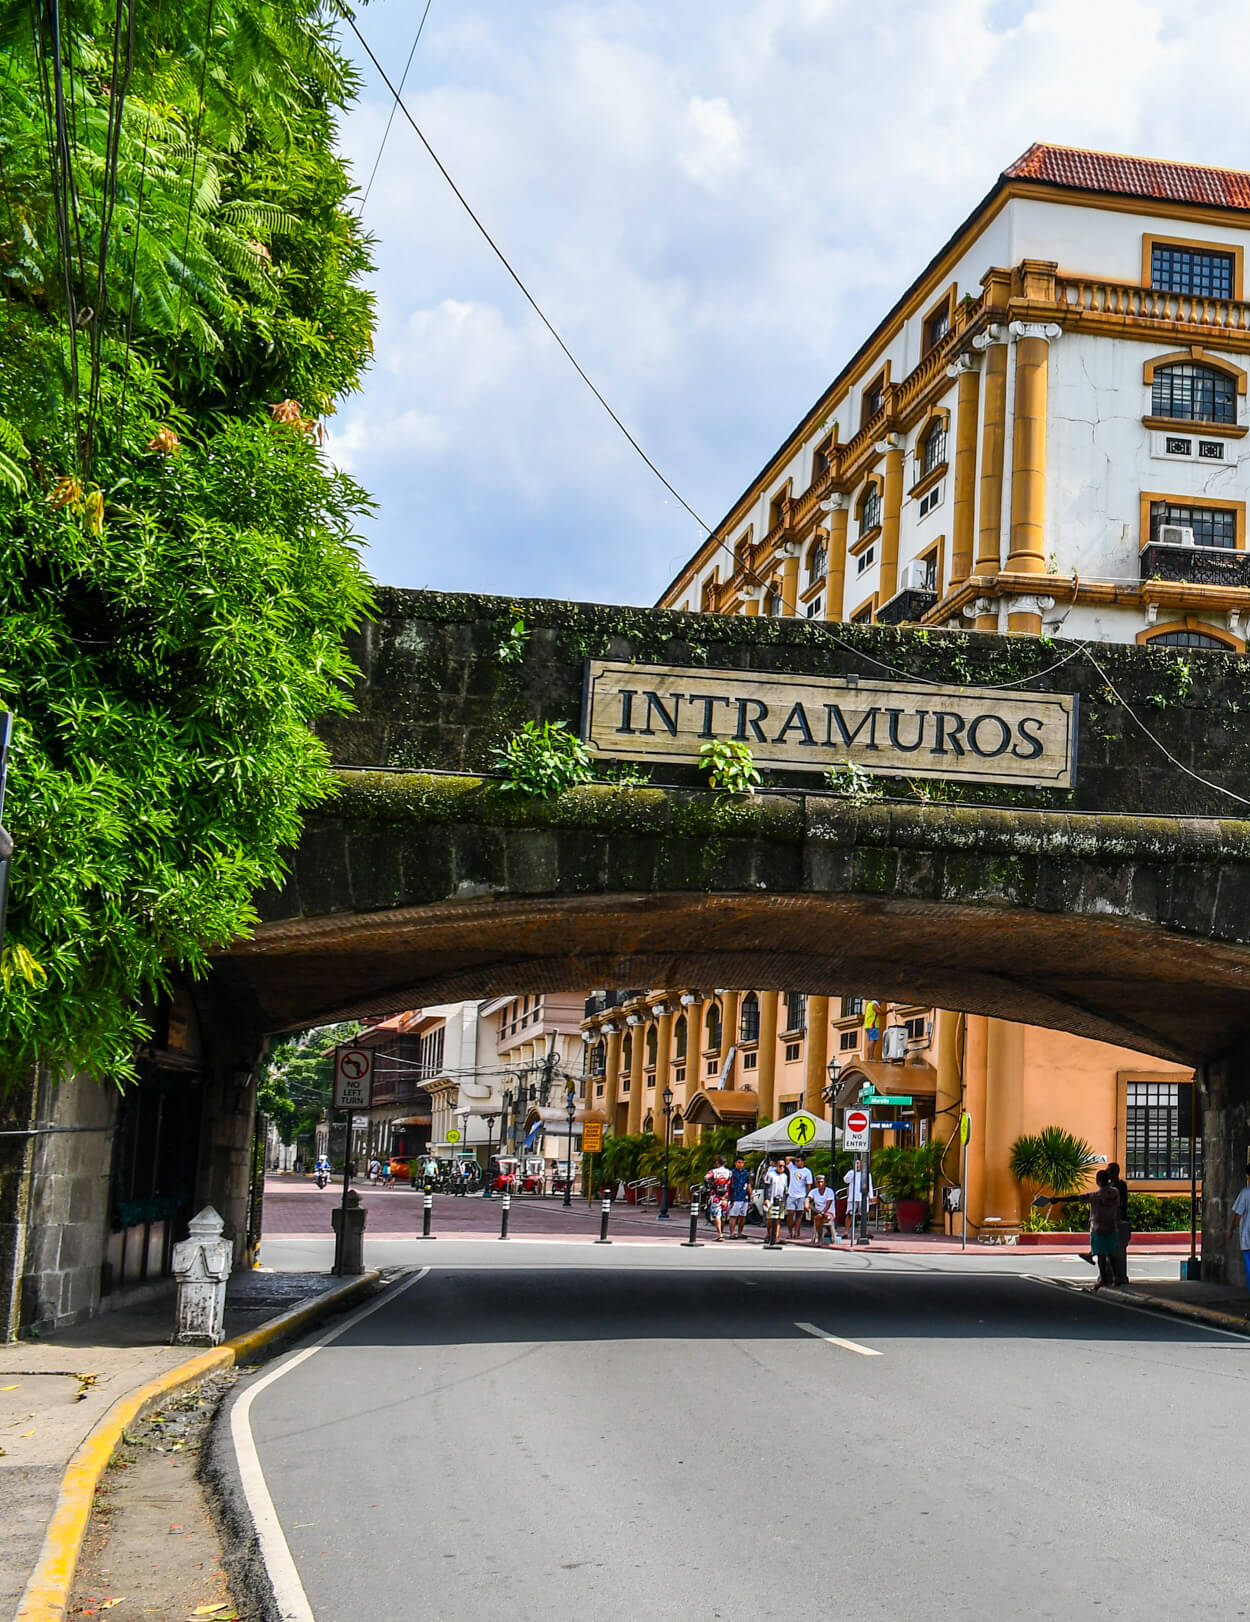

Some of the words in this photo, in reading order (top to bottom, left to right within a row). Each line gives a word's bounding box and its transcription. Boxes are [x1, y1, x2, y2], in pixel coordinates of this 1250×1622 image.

[615, 689, 1045, 761] INTRAMUROS
[346, 1081, 361, 1089] NO
[343, 1089, 362, 1097] LEFT
[341, 1096, 364, 1105] TURN
